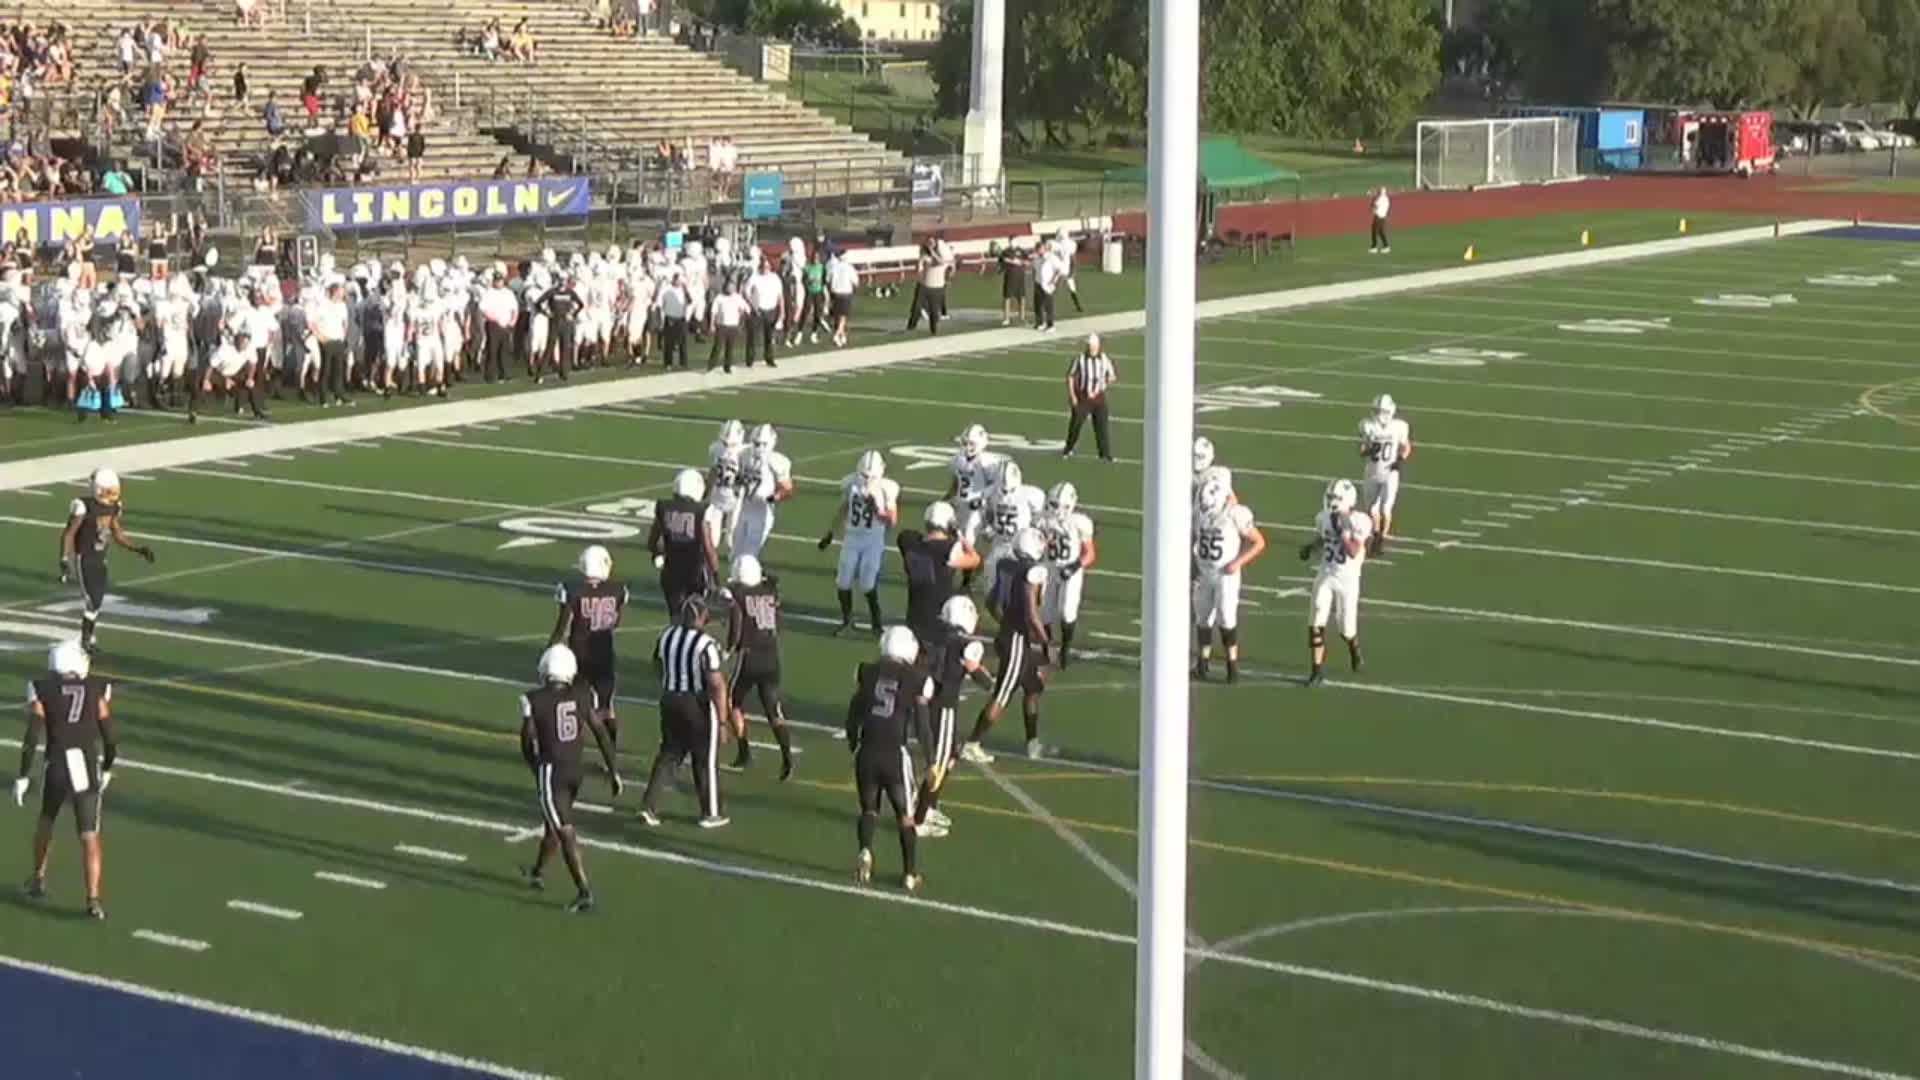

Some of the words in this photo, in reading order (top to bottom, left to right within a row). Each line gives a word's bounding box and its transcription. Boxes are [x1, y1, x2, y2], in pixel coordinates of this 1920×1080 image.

[320, 182, 542, 226] LINCOLN
[1371, 441, 1393, 463] 20
[61, 685, 85, 723] 7
[872, 680, 899, 719] 5
[556, 700, 577, 742] 6
